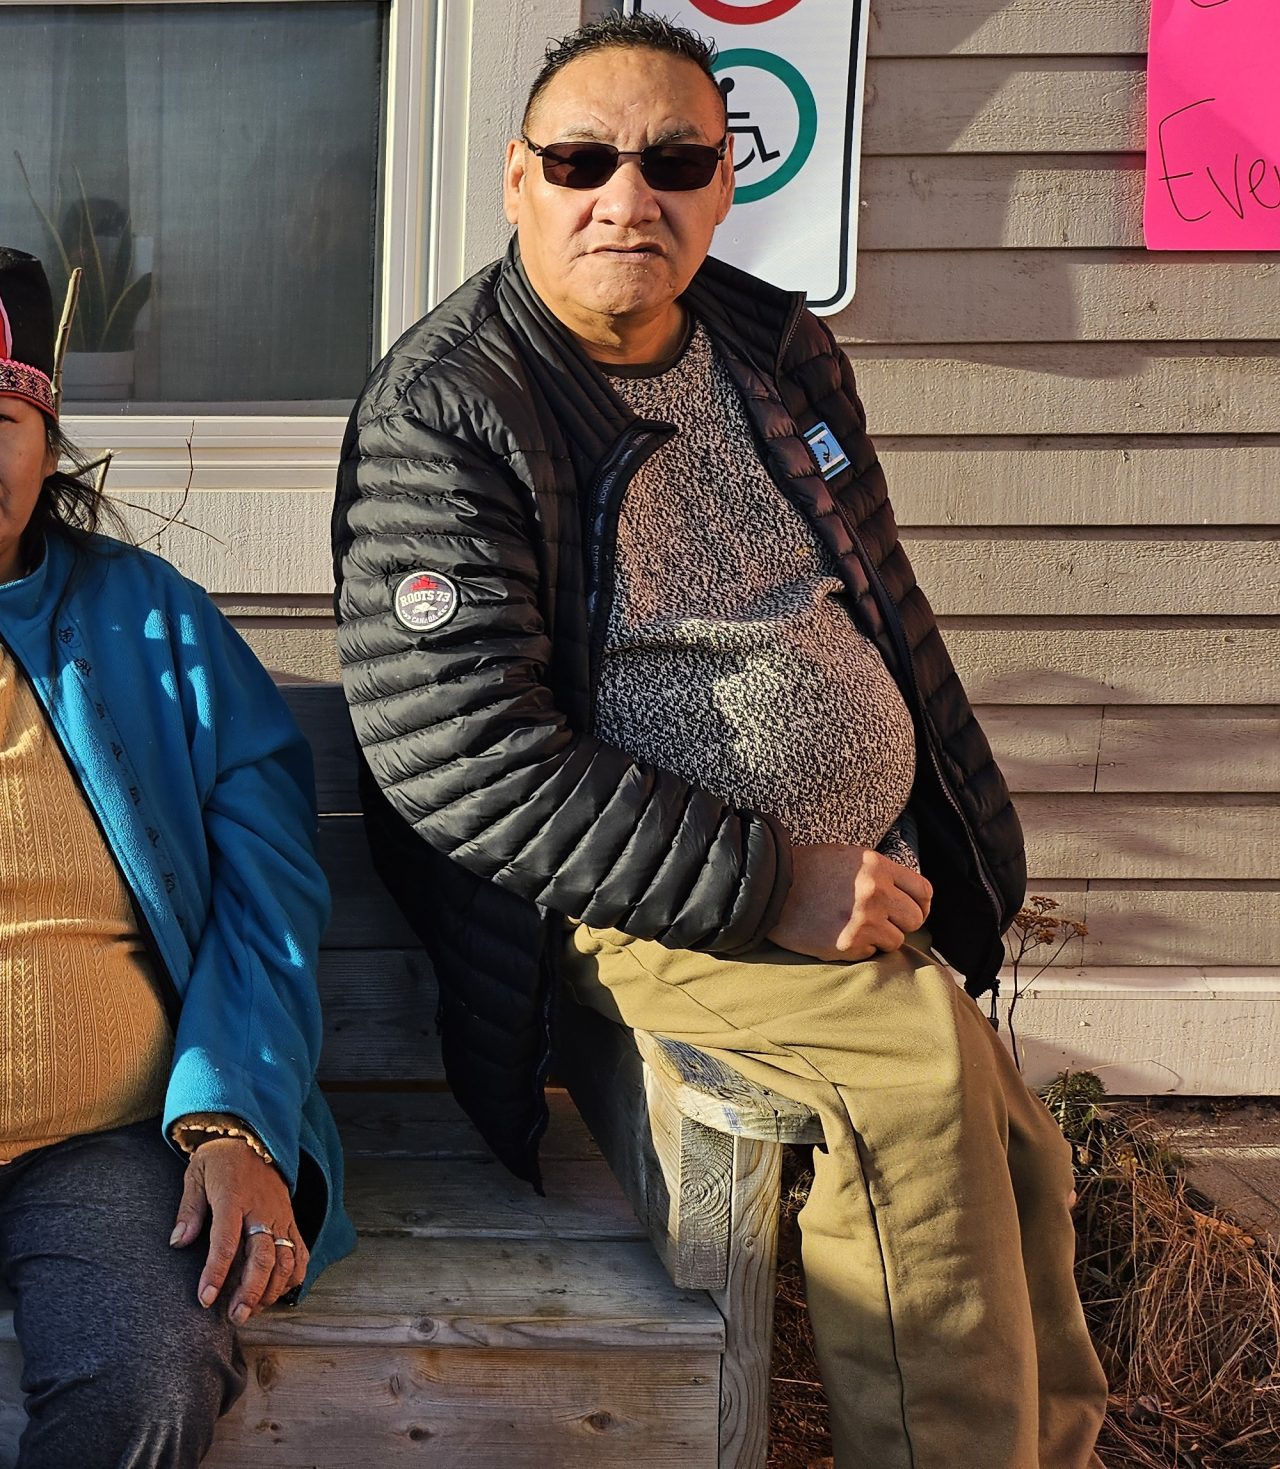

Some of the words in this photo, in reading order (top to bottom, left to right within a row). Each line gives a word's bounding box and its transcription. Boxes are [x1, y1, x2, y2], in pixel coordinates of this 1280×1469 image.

[1159, 98, 1280, 222] Eve
[400, 590, 434, 607] ROOTS
[436, 591, 451, 603] 73
